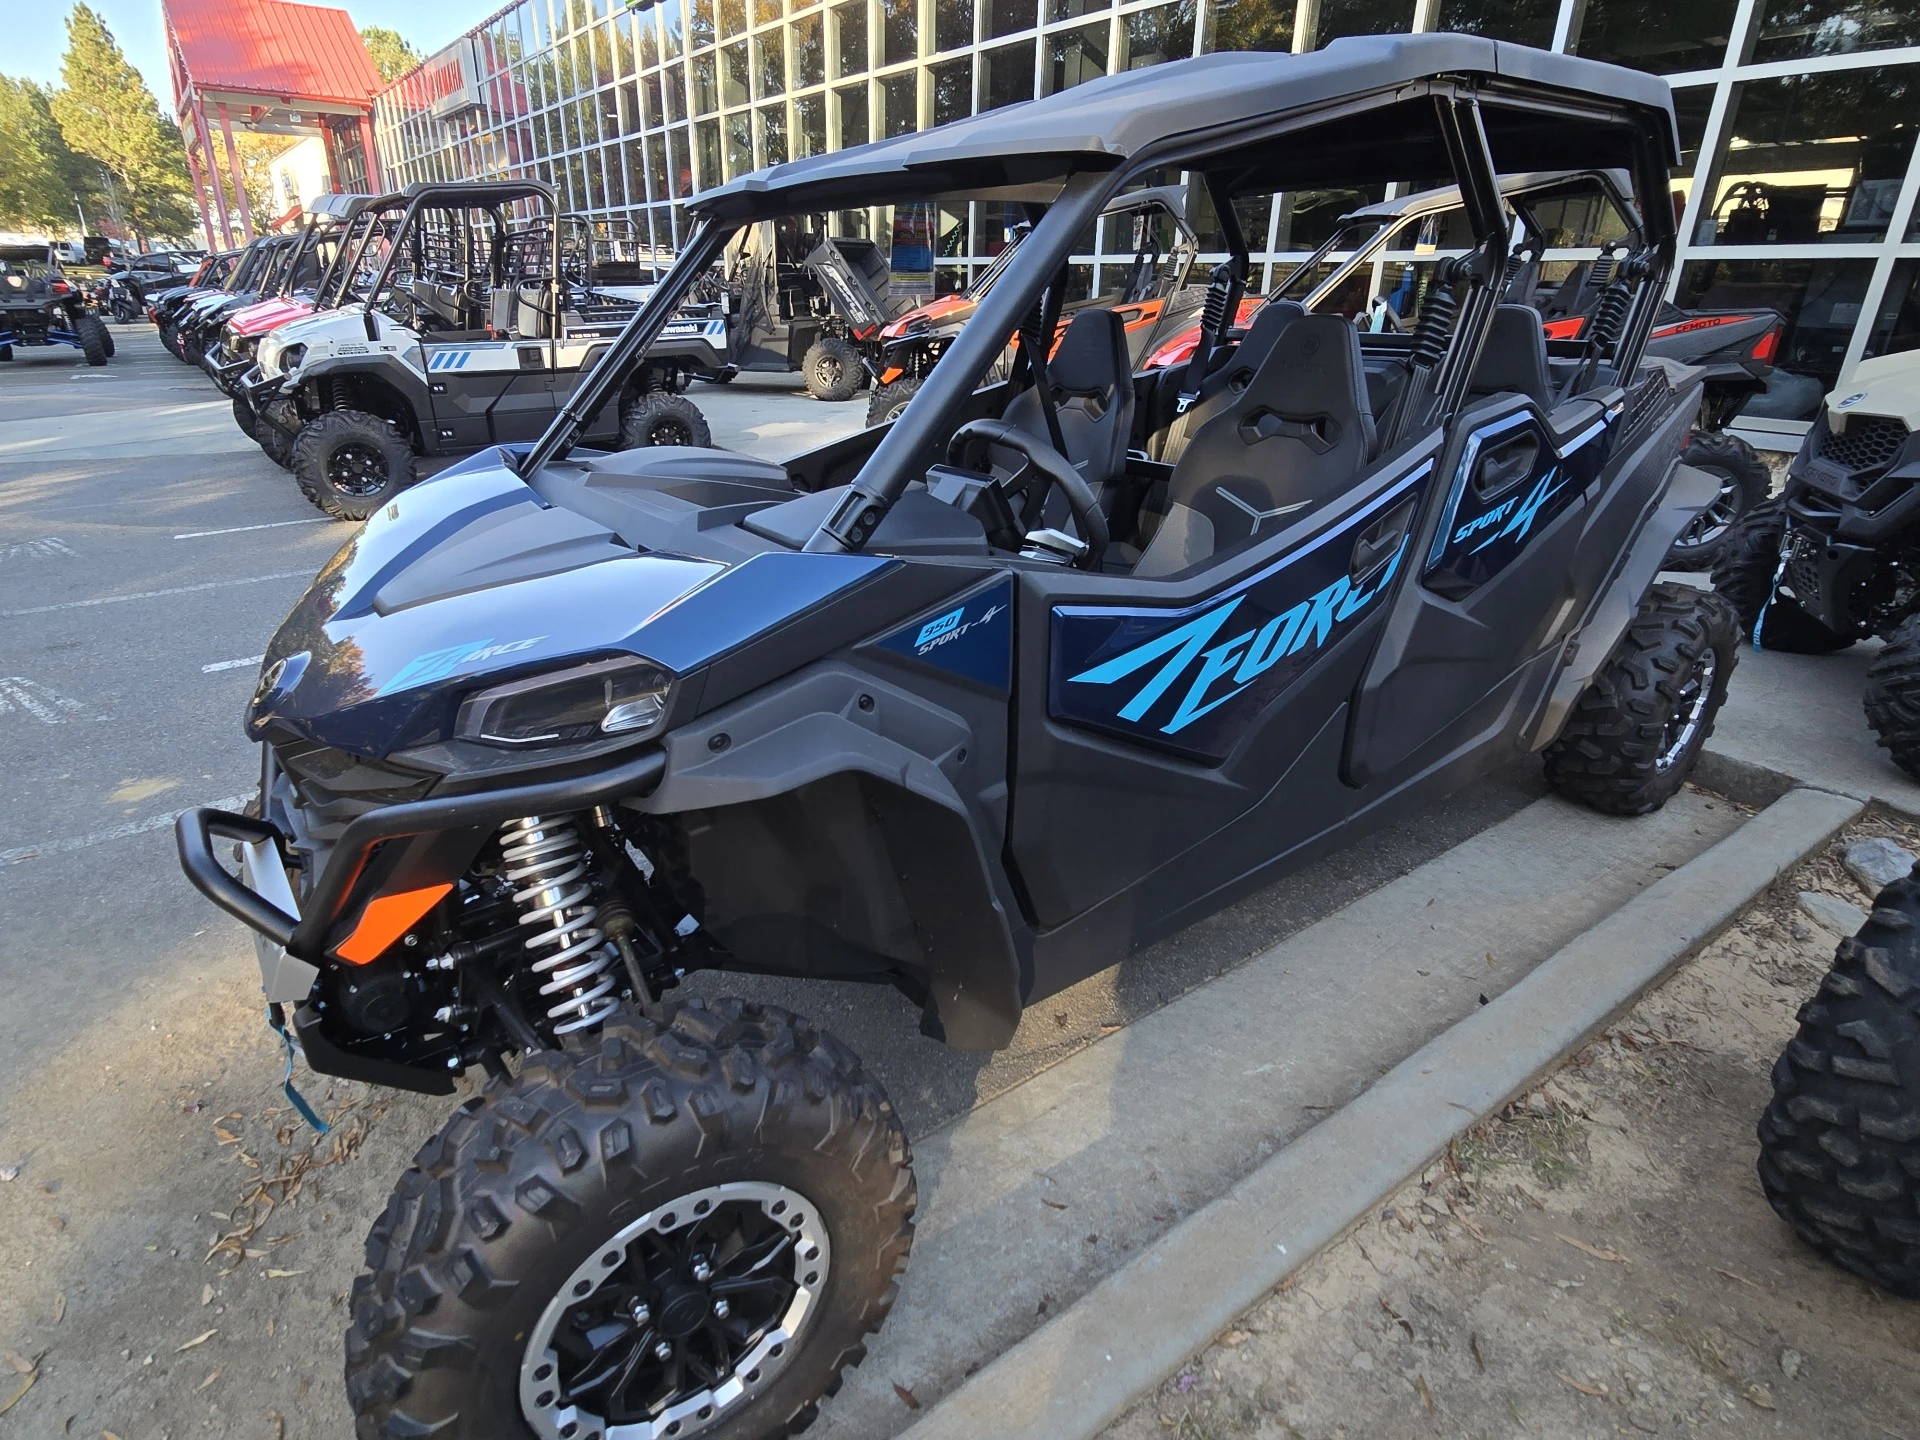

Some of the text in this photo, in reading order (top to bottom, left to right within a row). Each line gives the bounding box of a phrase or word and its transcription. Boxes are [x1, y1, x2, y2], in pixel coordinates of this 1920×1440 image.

[433, 58, 464, 100] YAMAHA
[660, 323, 698, 335] awasaki
[1452, 465, 1572, 548] SPORT 4
[922, 615, 957, 640] 950
